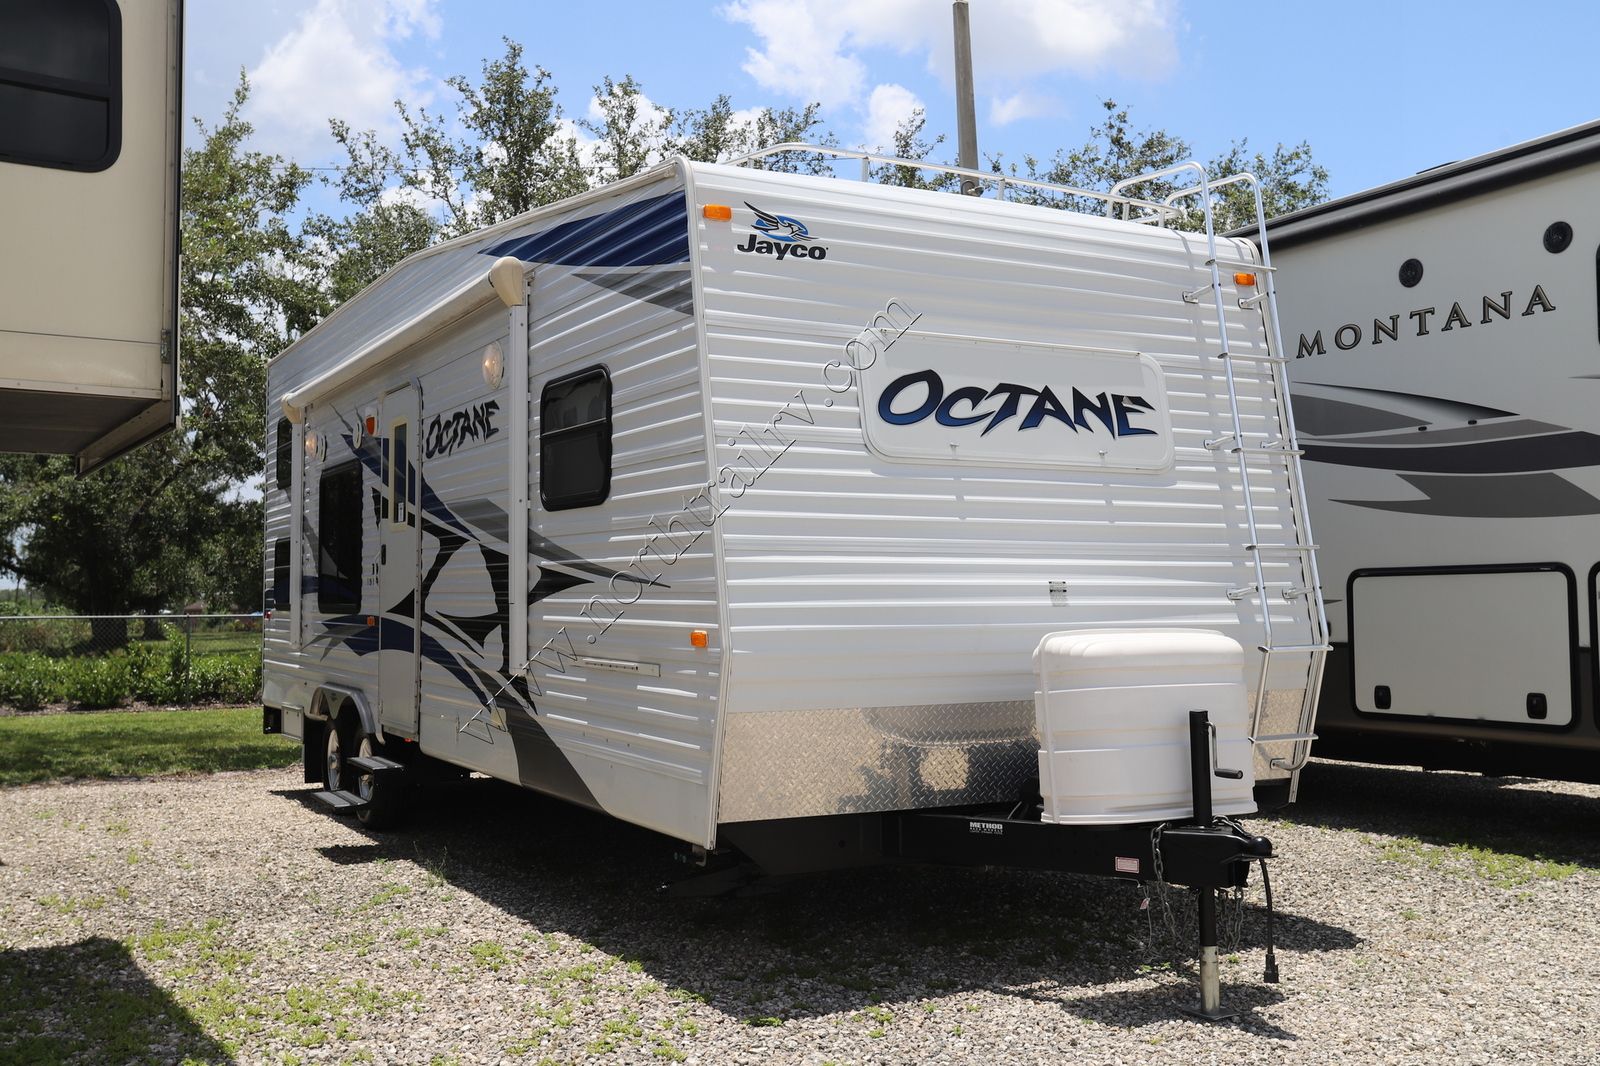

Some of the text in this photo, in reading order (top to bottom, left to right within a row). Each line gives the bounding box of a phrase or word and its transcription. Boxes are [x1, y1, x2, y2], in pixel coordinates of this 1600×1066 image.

[737, 234, 827, 261] Jayco
[1296, 285, 1556, 359] MONTANA
[425, 400, 500, 459] OCTANE
[877, 369, 1158, 440] OCTANE
[969, 821, 1003, 830] METHOD
